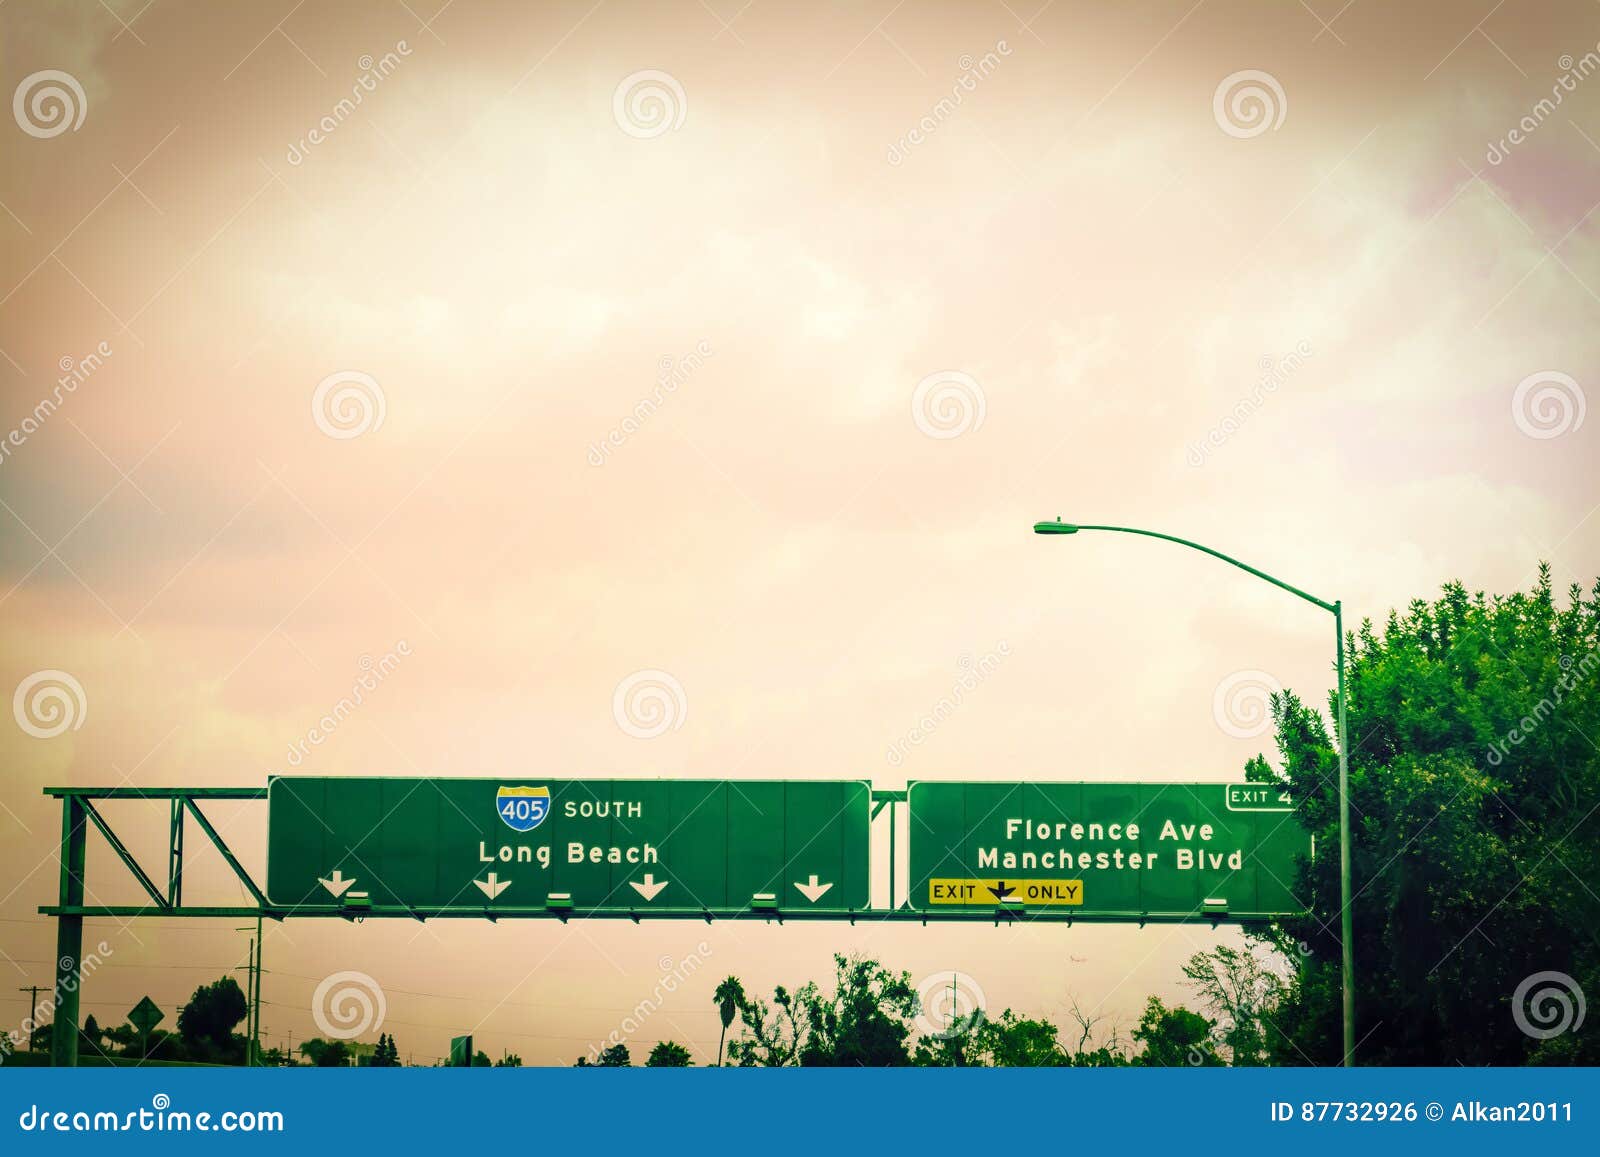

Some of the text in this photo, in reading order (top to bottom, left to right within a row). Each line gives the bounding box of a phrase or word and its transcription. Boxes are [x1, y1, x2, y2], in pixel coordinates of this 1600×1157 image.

[1231, 791, 1268, 802] EXIT
[501, 801, 642, 820] 405 SOUTH
[1006, 819, 1214, 840] Florence Ave
[479, 841, 659, 869] Long Beach
[978, 848, 1243, 870] Manchester Blvd
[933, 885, 1078, 899] EXIT ONLY
